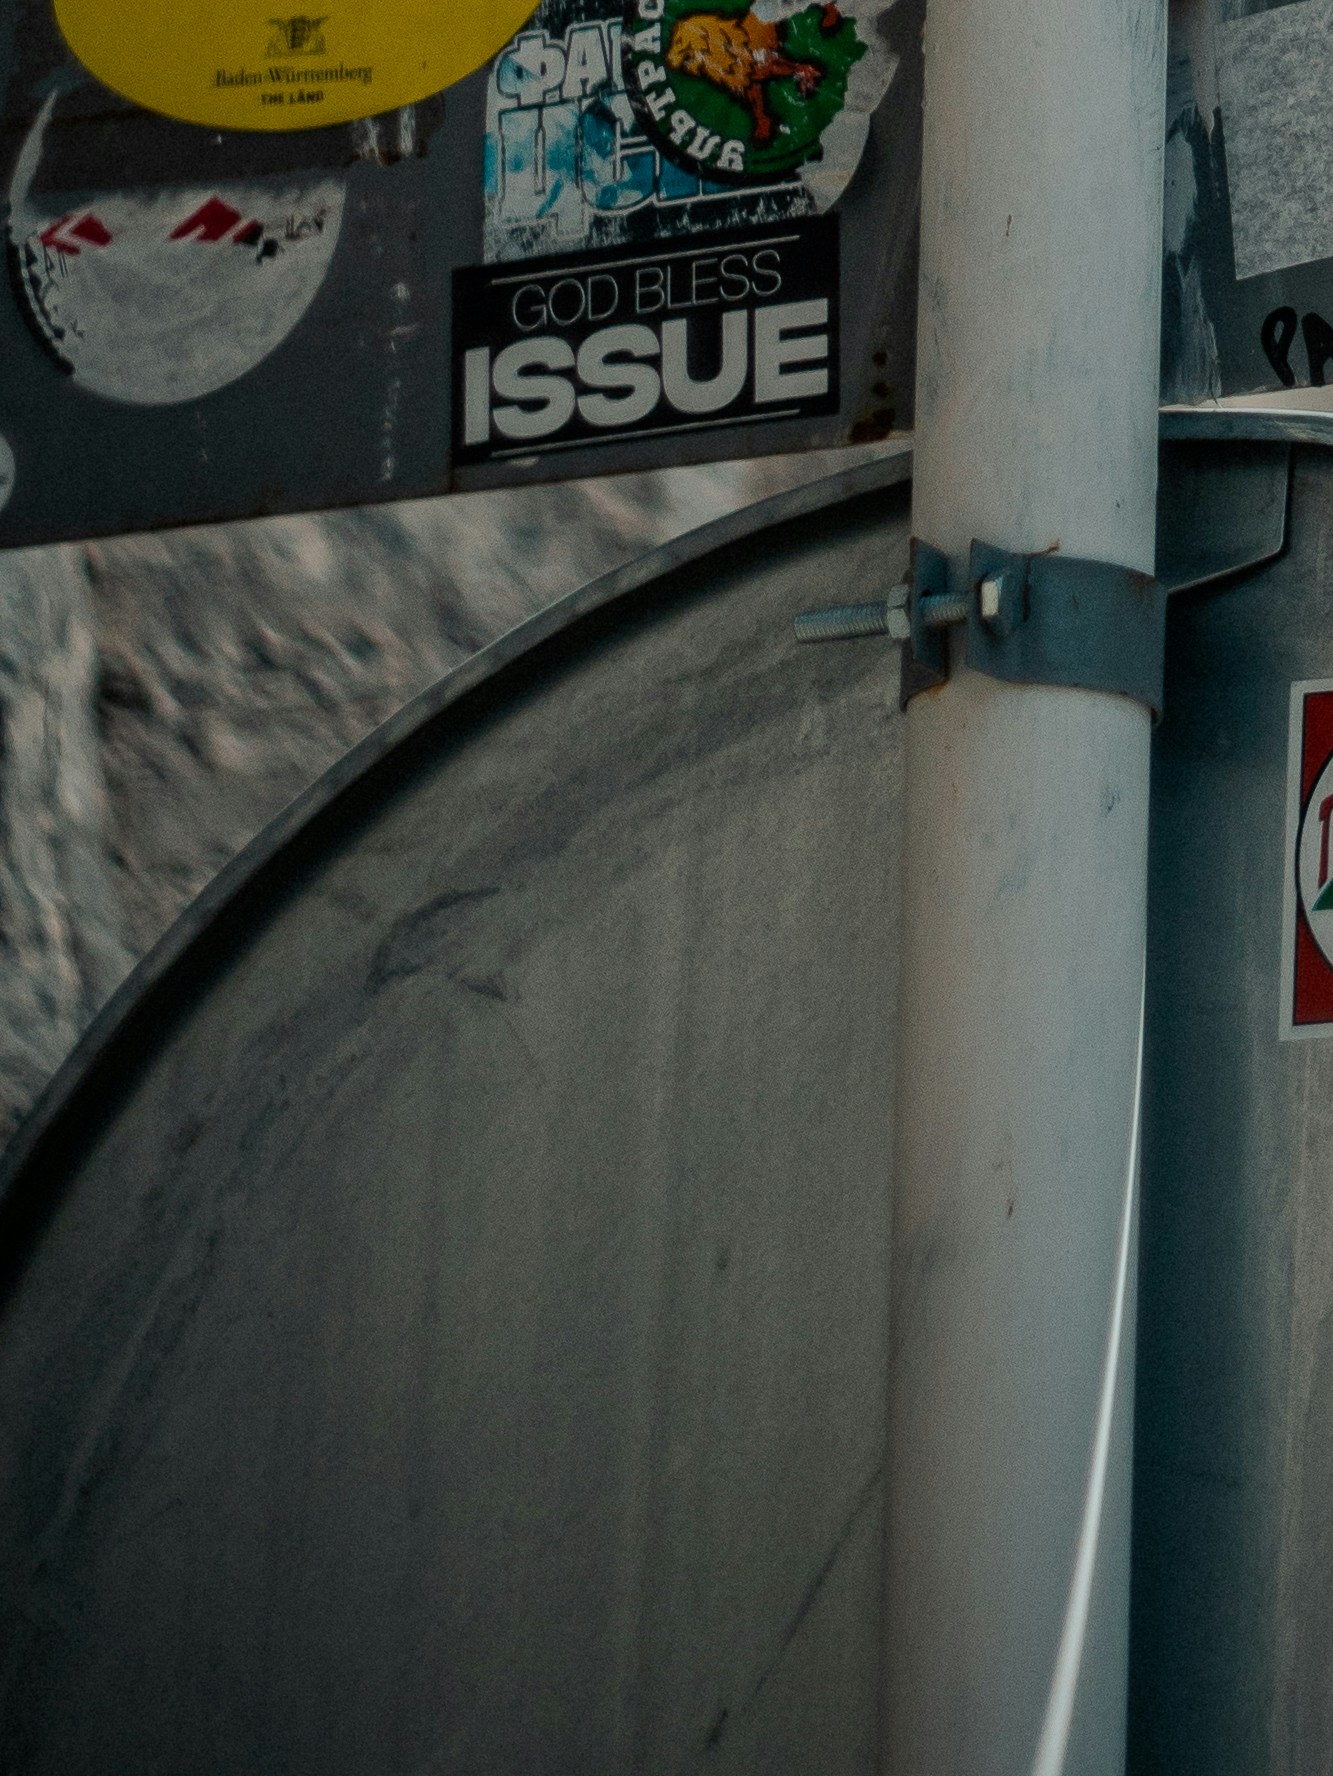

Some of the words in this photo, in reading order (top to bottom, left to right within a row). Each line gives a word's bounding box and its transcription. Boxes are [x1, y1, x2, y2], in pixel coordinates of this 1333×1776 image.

[260, 92, 286, 107] THE
[511, 273, 620, 332] GOD
[634, 249, 783, 315] BLESS
[464, 297, 829, 447] ISSUE
